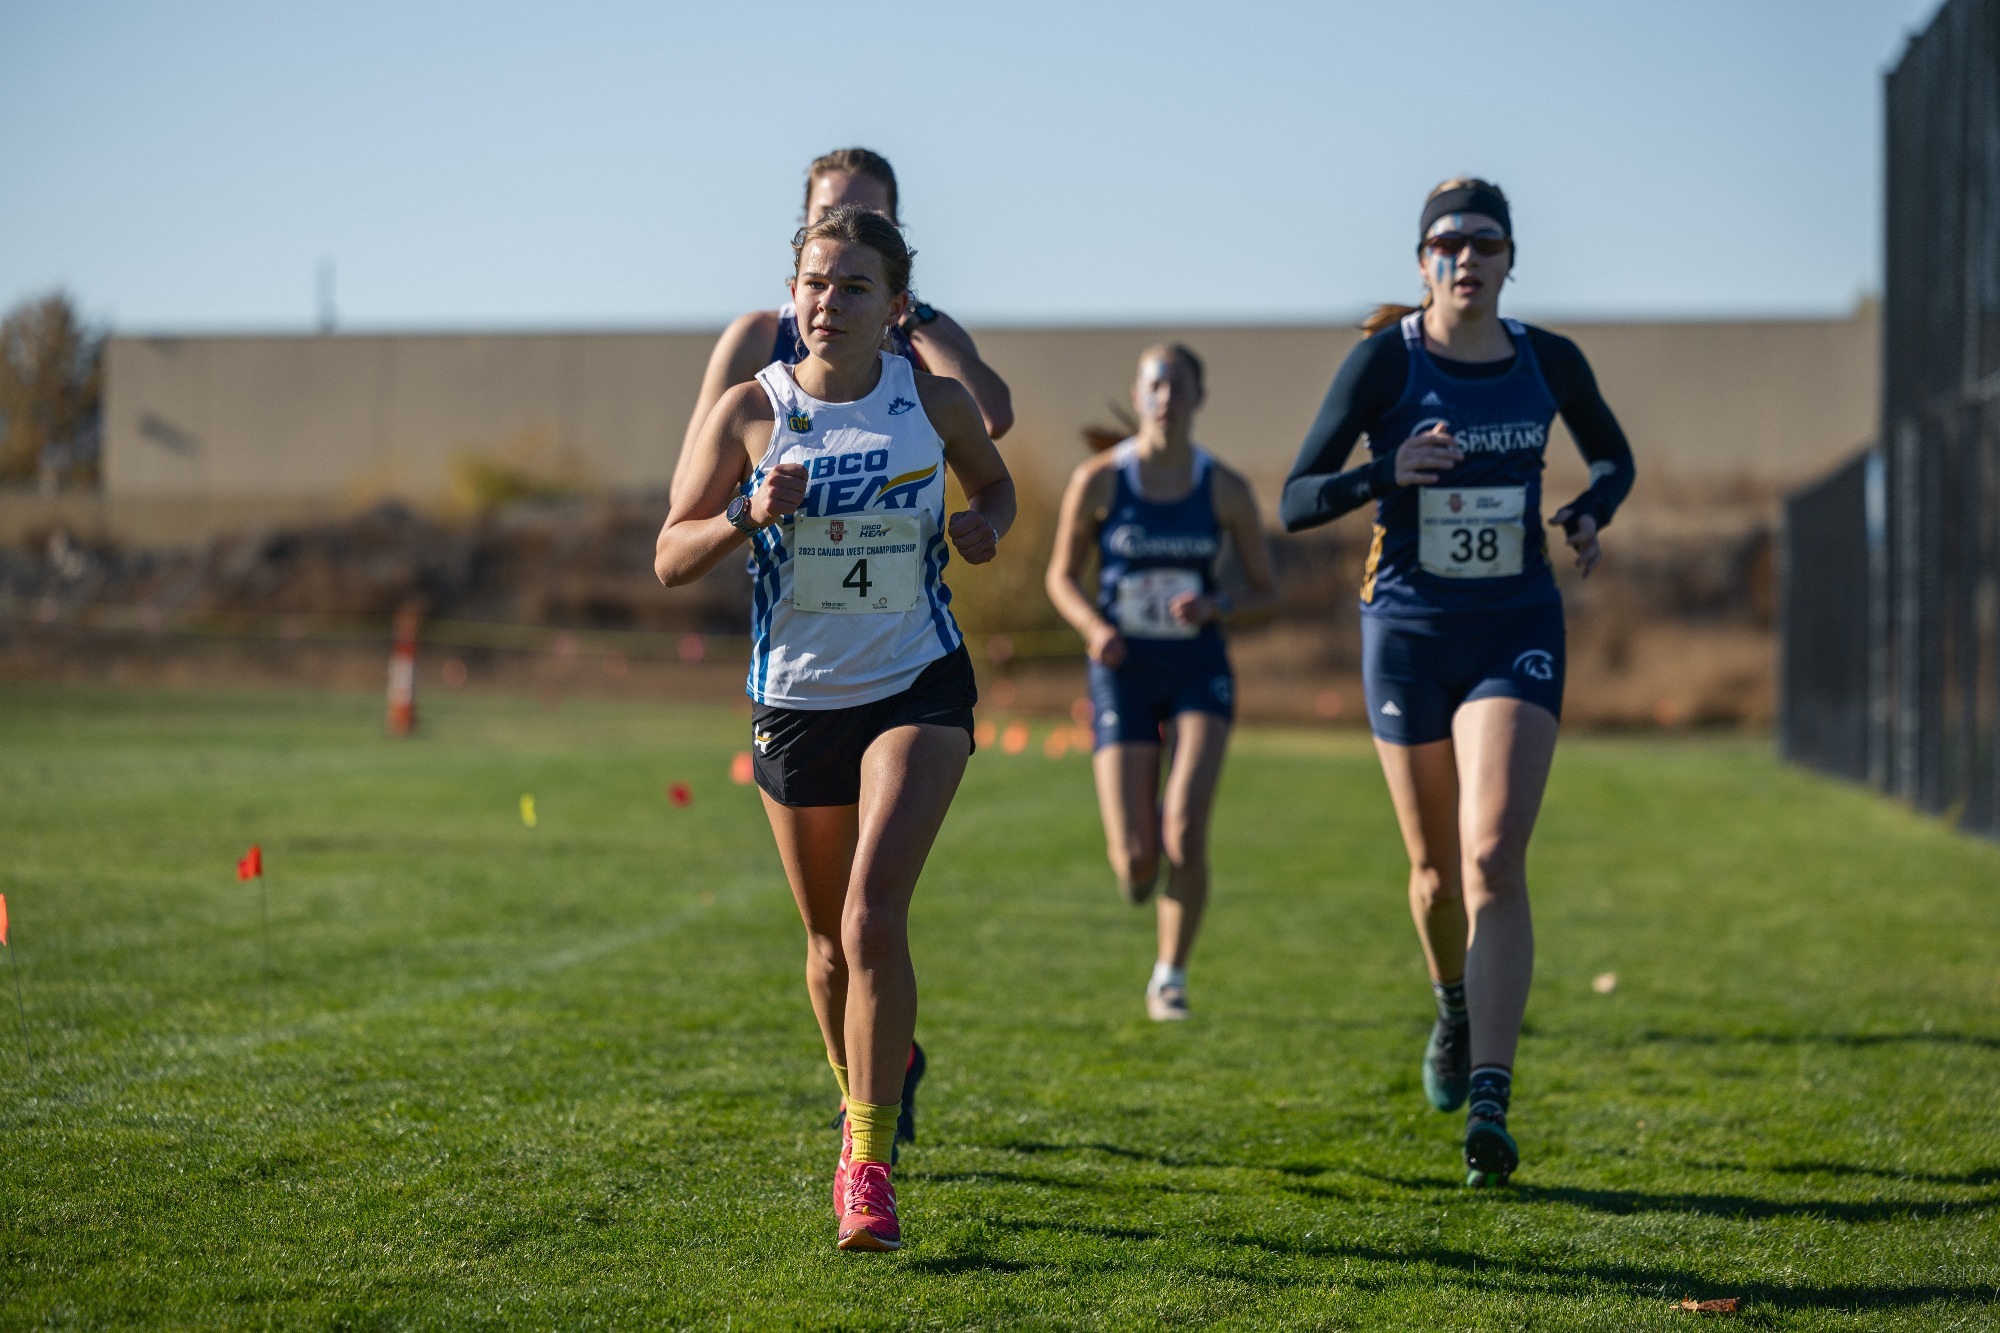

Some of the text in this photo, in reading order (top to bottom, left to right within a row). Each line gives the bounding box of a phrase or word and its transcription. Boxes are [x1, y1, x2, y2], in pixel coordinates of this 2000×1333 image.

[1454, 423, 1545, 454] SPARTANS
[803, 449, 888, 480] BCO
[798, 543, 917, 557] 2023 CANADA WEST CHAMPIONSHIP
[1450, 527, 1498, 563] 38
[842, 558, 873, 598] 4
